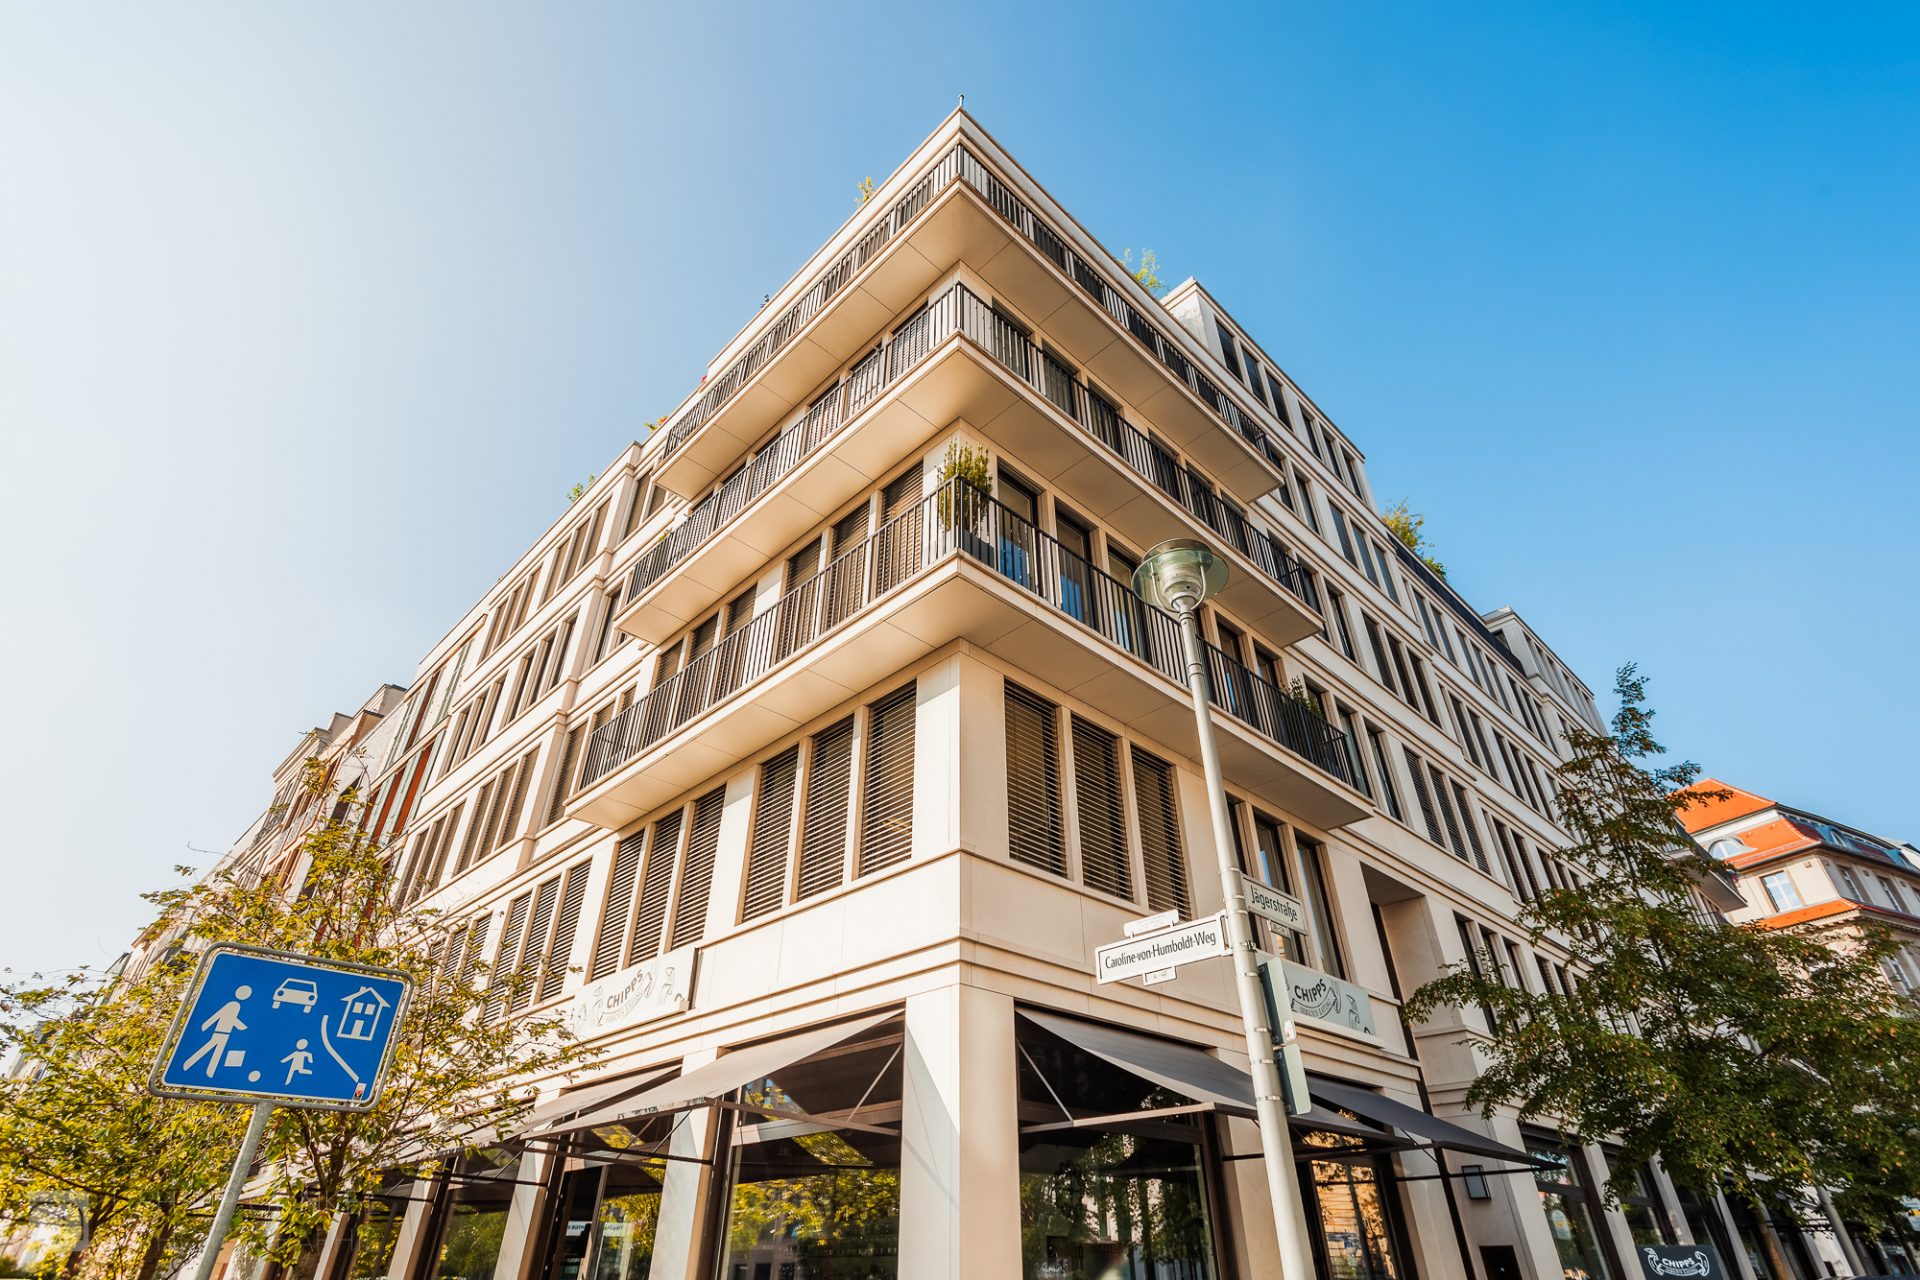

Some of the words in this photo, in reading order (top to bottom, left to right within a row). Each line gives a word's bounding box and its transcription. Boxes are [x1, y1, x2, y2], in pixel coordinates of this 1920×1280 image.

[1250, 884, 1298, 922] Jägerstraße
[1105, 931, 1216, 969] Caroline-von-Humboldt-Weg
[606, 969, 643, 1008] CHIPPS
[1294, 978, 1327, 1002] CHIPPS
[1662, 1257, 1695, 1268] CHIPPS
